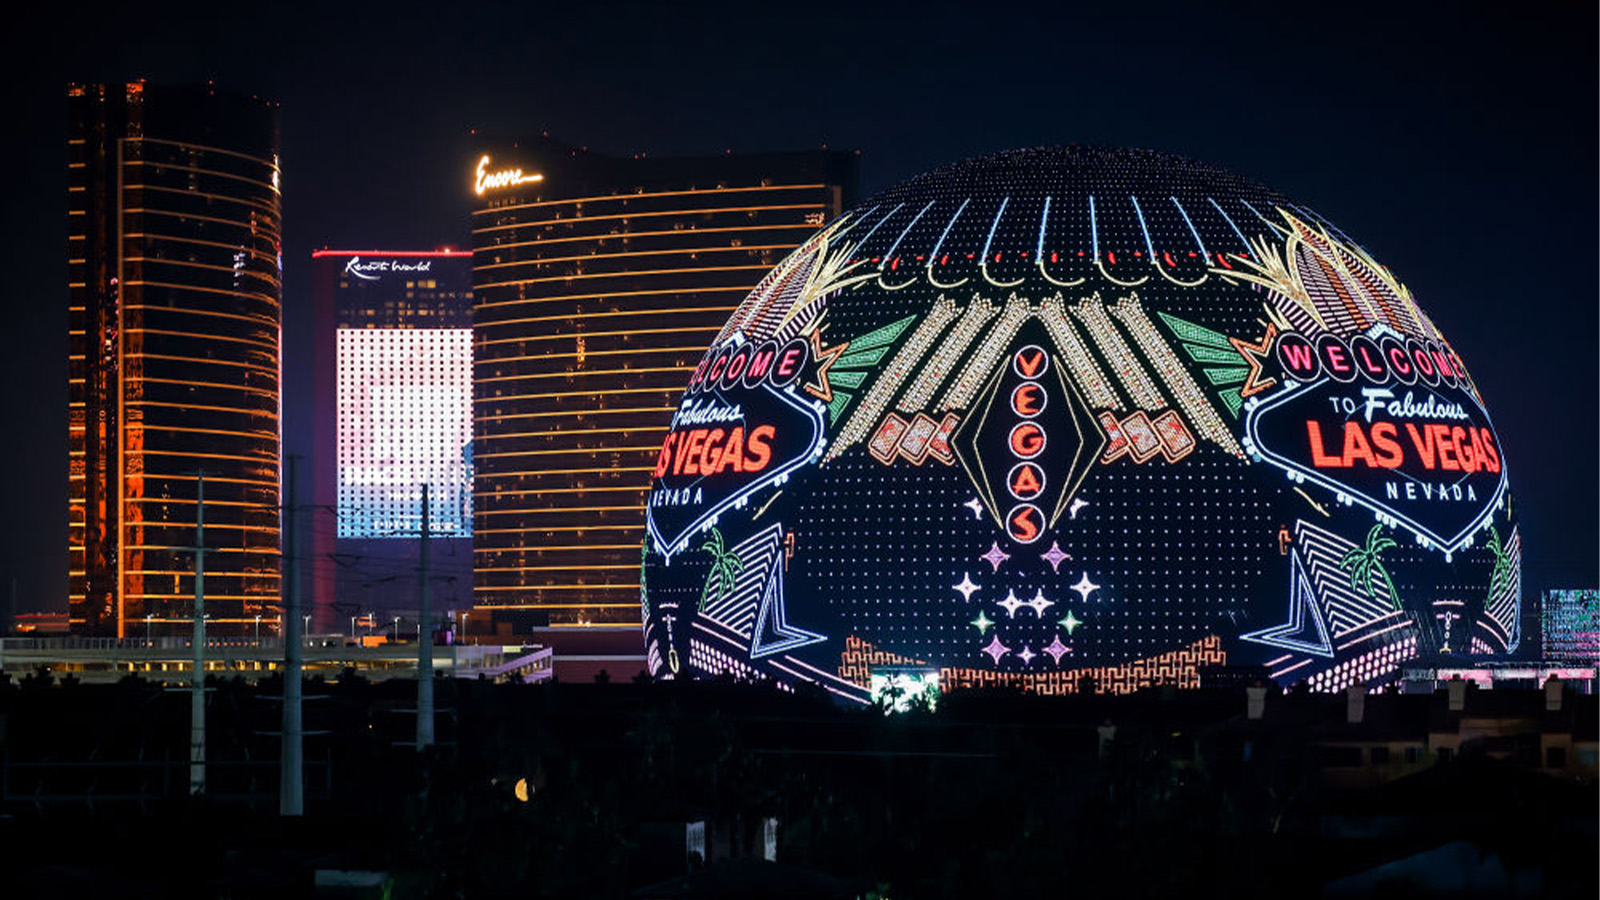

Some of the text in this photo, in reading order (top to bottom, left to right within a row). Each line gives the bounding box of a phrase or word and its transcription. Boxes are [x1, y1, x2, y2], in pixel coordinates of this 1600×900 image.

[474, 154, 544, 195] Encore
[1282, 345, 1465, 378] WELCOME
[1329, 387, 1469, 423] TO Fabulous
[673, 425, 775, 475] VEGAS
[1011, 351, 1044, 540] VEGAS
[1306, 420, 1499, 472] LAS VEGAS
[1386, 482, 1477, 500] NEVADA
